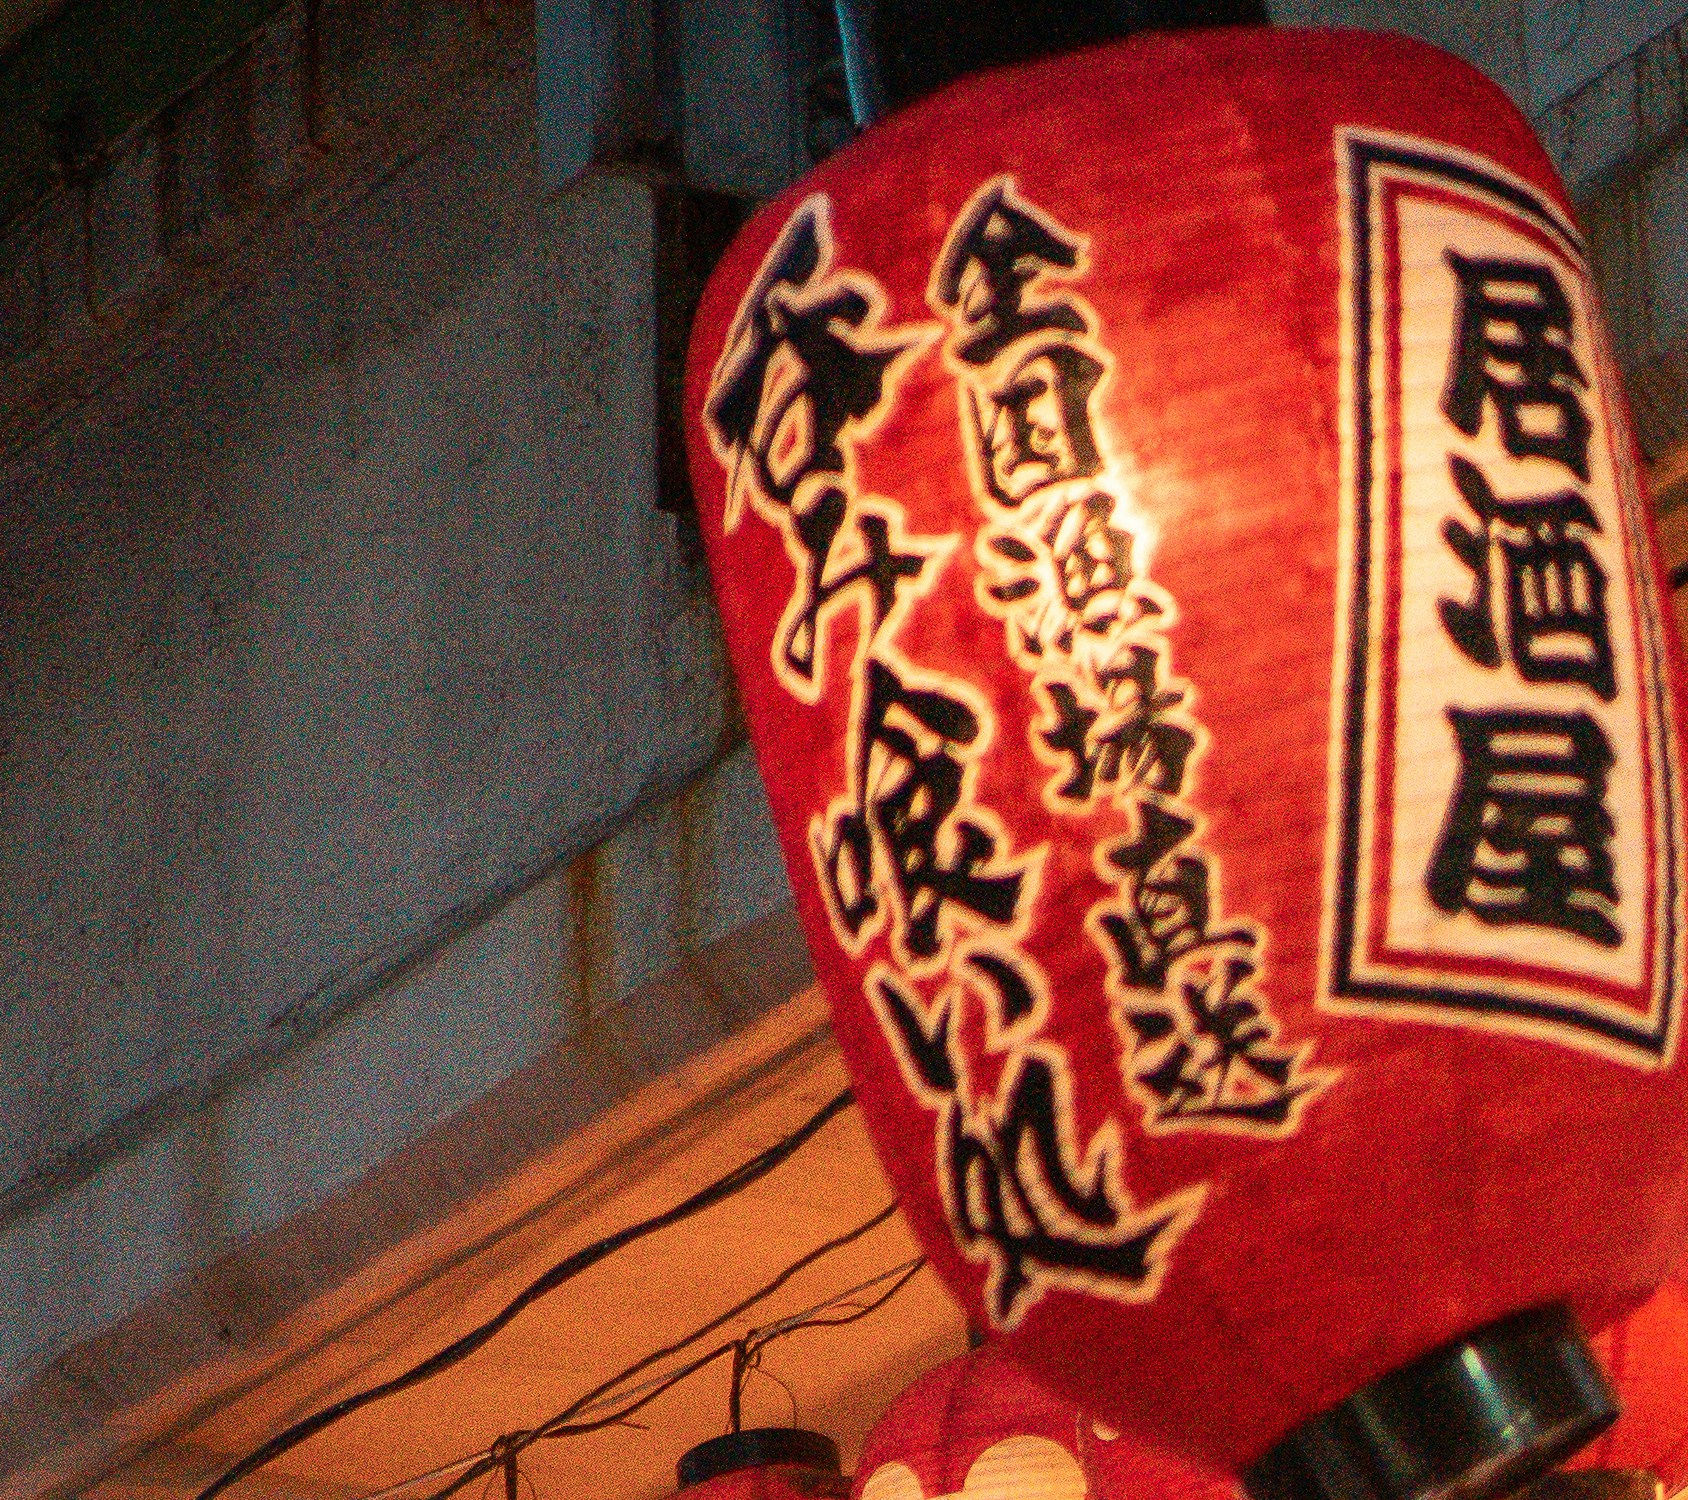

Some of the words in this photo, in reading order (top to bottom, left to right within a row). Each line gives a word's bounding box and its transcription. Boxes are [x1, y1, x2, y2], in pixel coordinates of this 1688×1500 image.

[930, 178, 1322, 1138] 全国漁場直送
[1424, 243, 1624, 948] 居酒屋
